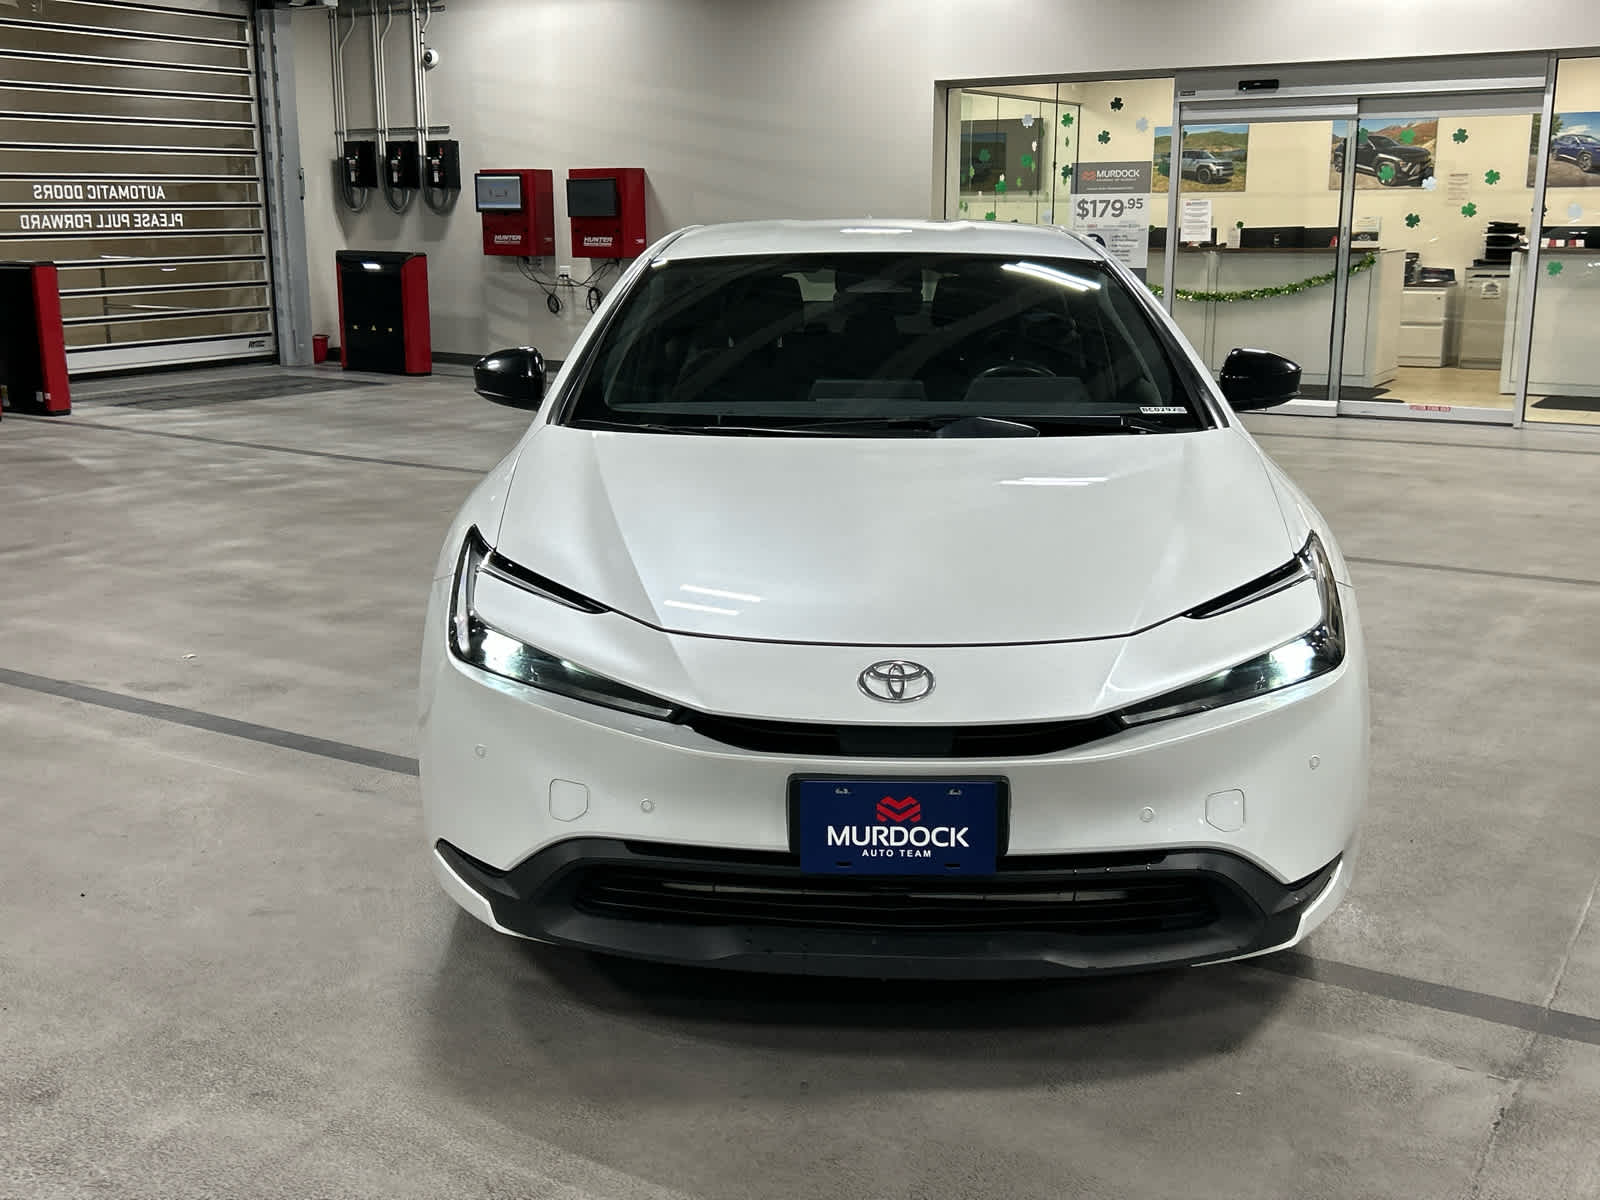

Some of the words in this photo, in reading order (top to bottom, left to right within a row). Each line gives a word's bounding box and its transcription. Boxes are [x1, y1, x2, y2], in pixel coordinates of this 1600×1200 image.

[1096, 169, 1140, 178] MURDOCK
[1076, 198, 1144, 220] $179.95
[827, 825, 970, 848] MURDOCK
[862, 849, 894, 857] AUTO
[899, 849, 932, 858] TEAM
